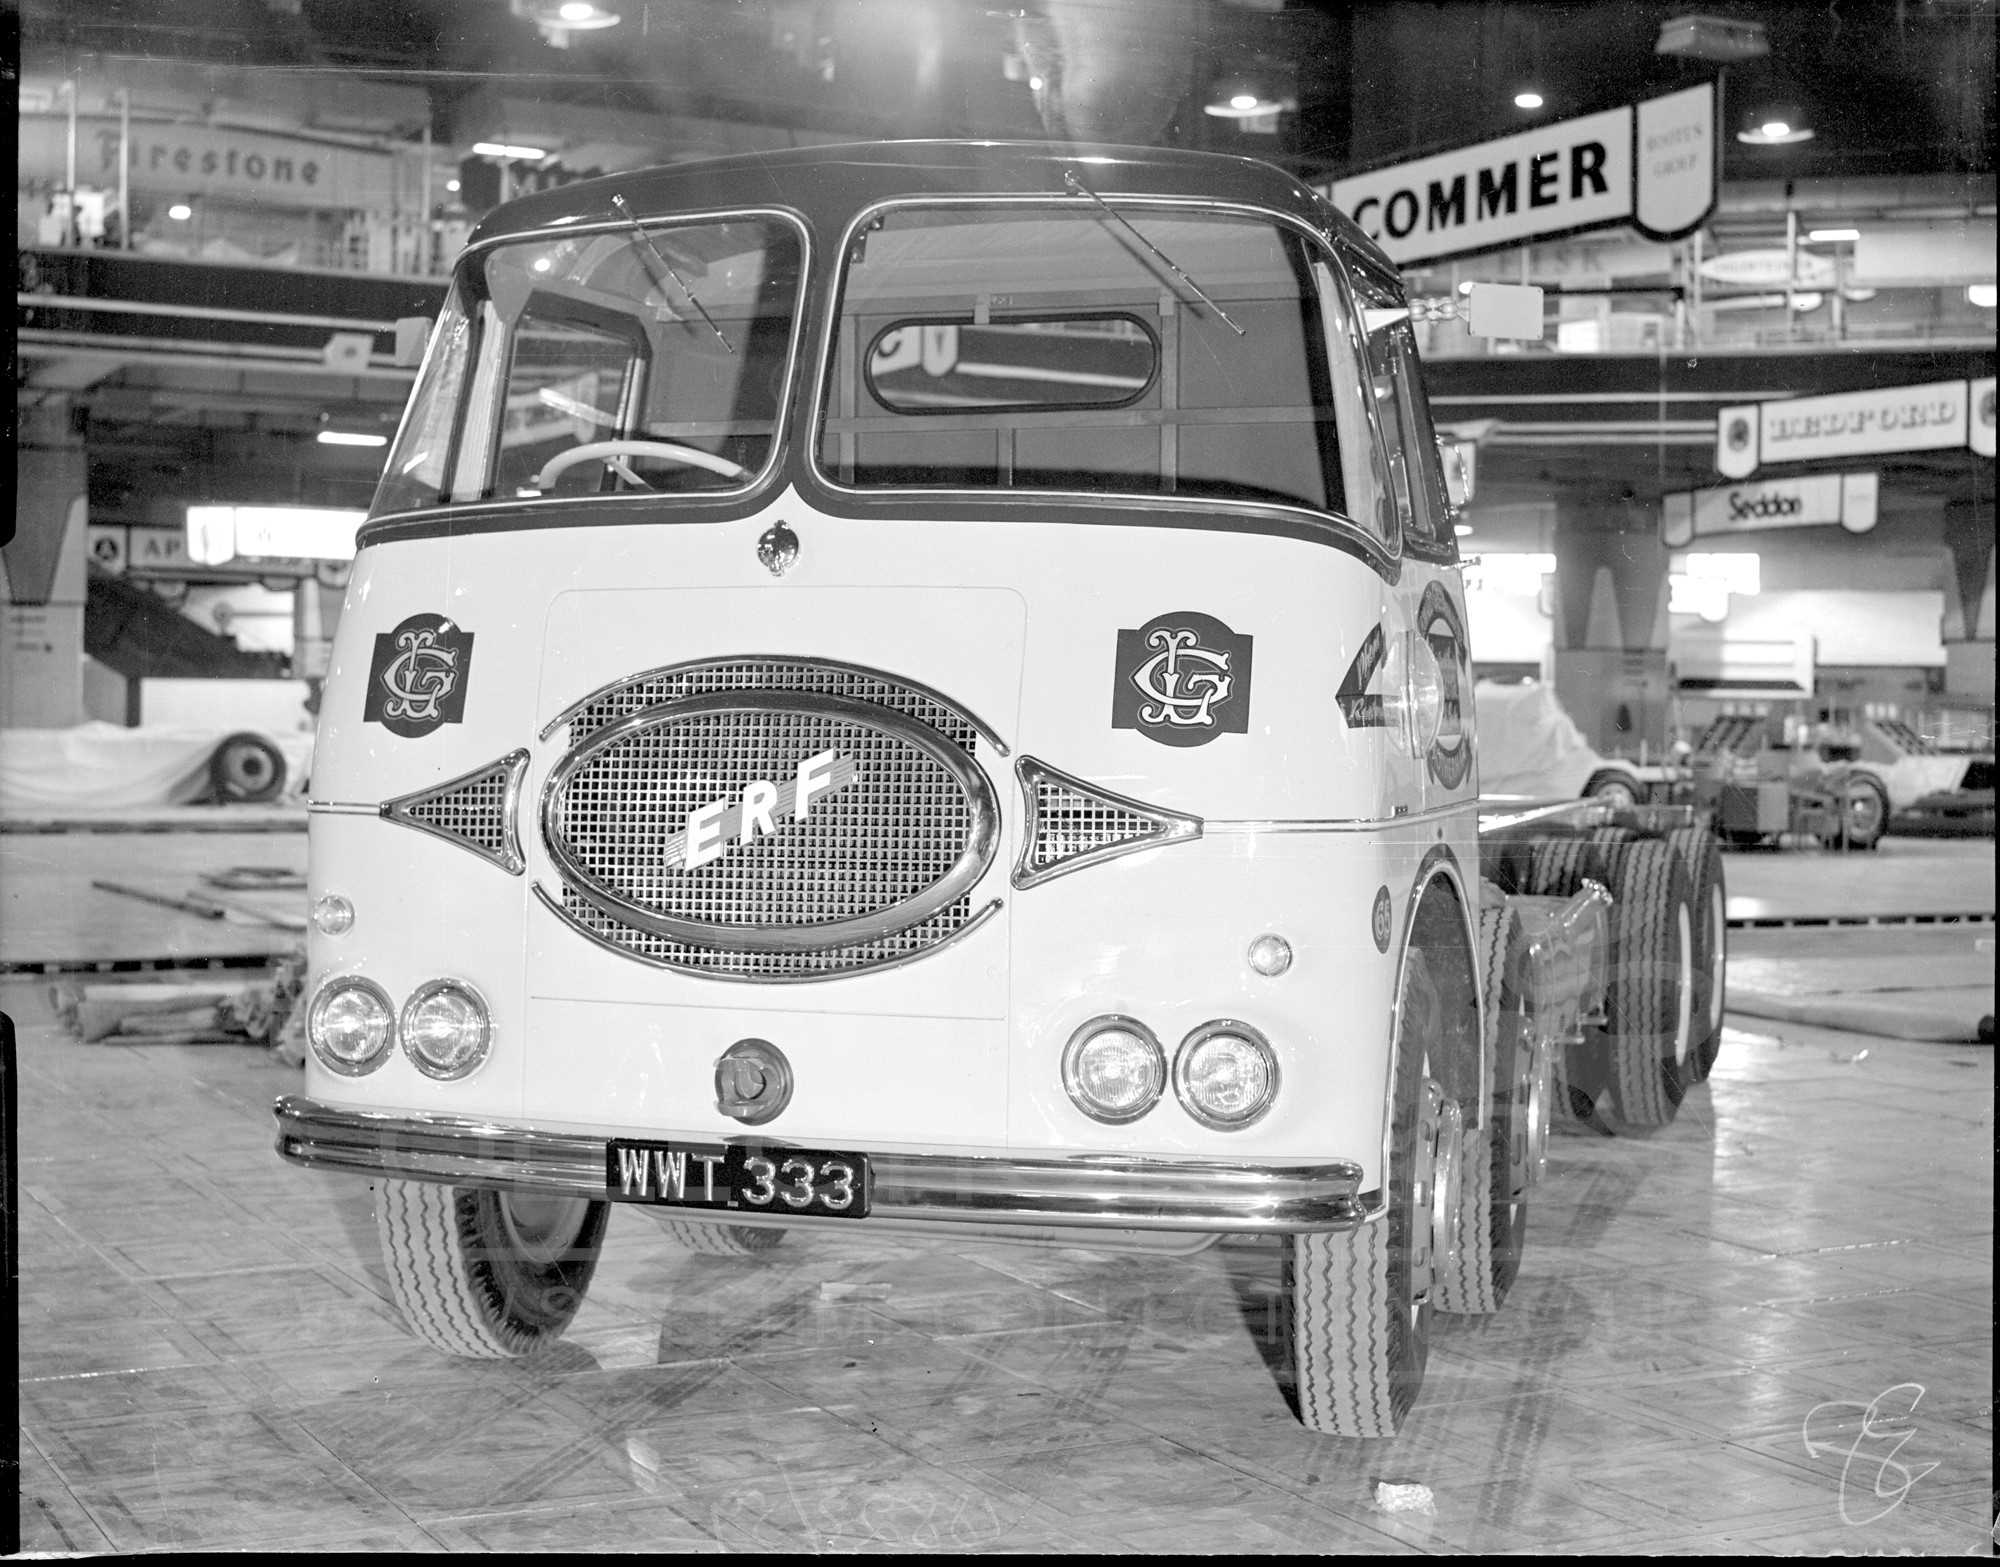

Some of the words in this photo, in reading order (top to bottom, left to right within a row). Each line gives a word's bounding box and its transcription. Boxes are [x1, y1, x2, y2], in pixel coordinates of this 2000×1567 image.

[95, 128, 320, 186] Firestone
[1352, 140, 1609, 241] COMMER
[1769, 400, 1958, 442] BEDFORD
[1728, 490, 1802, 522] Seddon
[685, 748, 839, 872] ERF
[617, 1148, 725, 1201] WWT
[742, 1155, 854, 1210] 333
